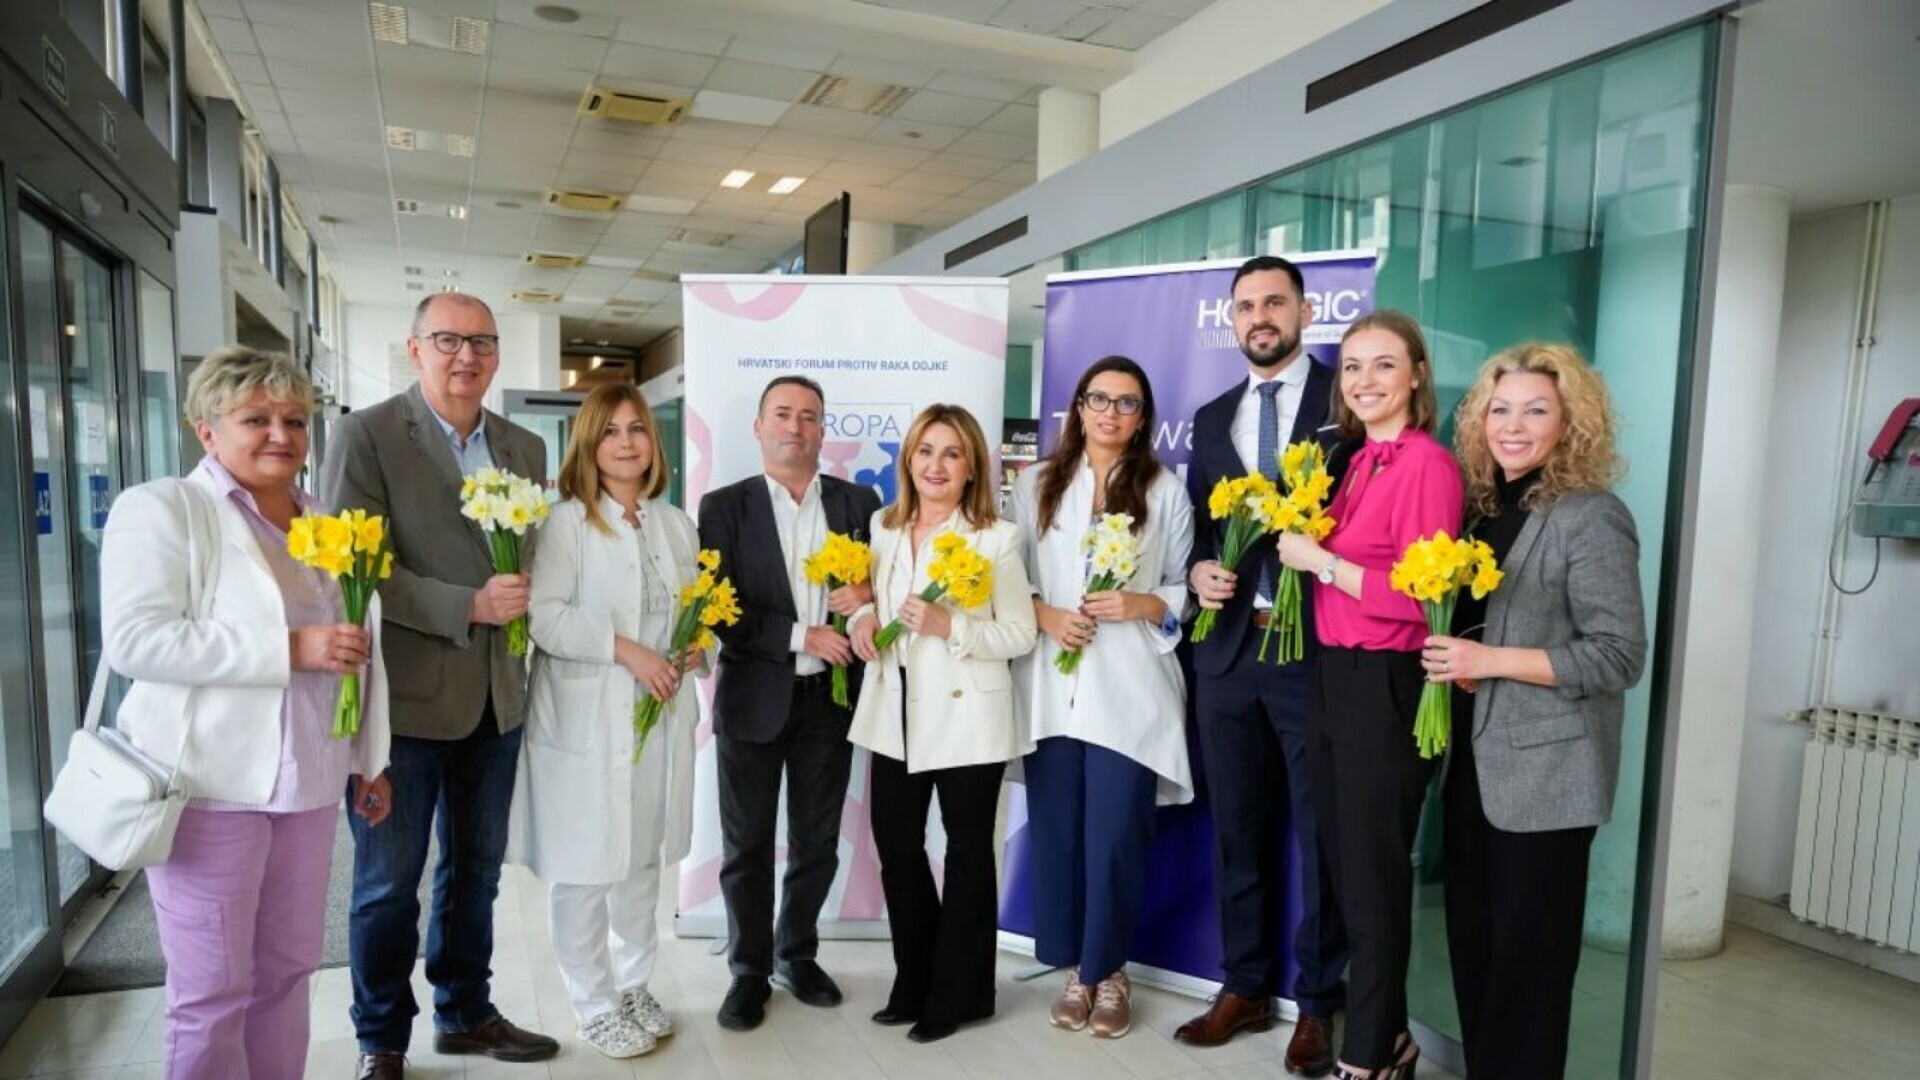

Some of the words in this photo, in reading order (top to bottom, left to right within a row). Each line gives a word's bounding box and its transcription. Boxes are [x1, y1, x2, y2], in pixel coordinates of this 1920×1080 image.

[1197, 289, 1360, 329] HGIC
[737, 358, 792, 369] HRVATSKI
[795, 359, 835, 370] FORUM
[837, 360, 878, 371] PROTIV
[880, 361, 910, 371] RAKA
[912, 361, 949, 371] DOJKE
[823, 414, 900, 438] ROPA
